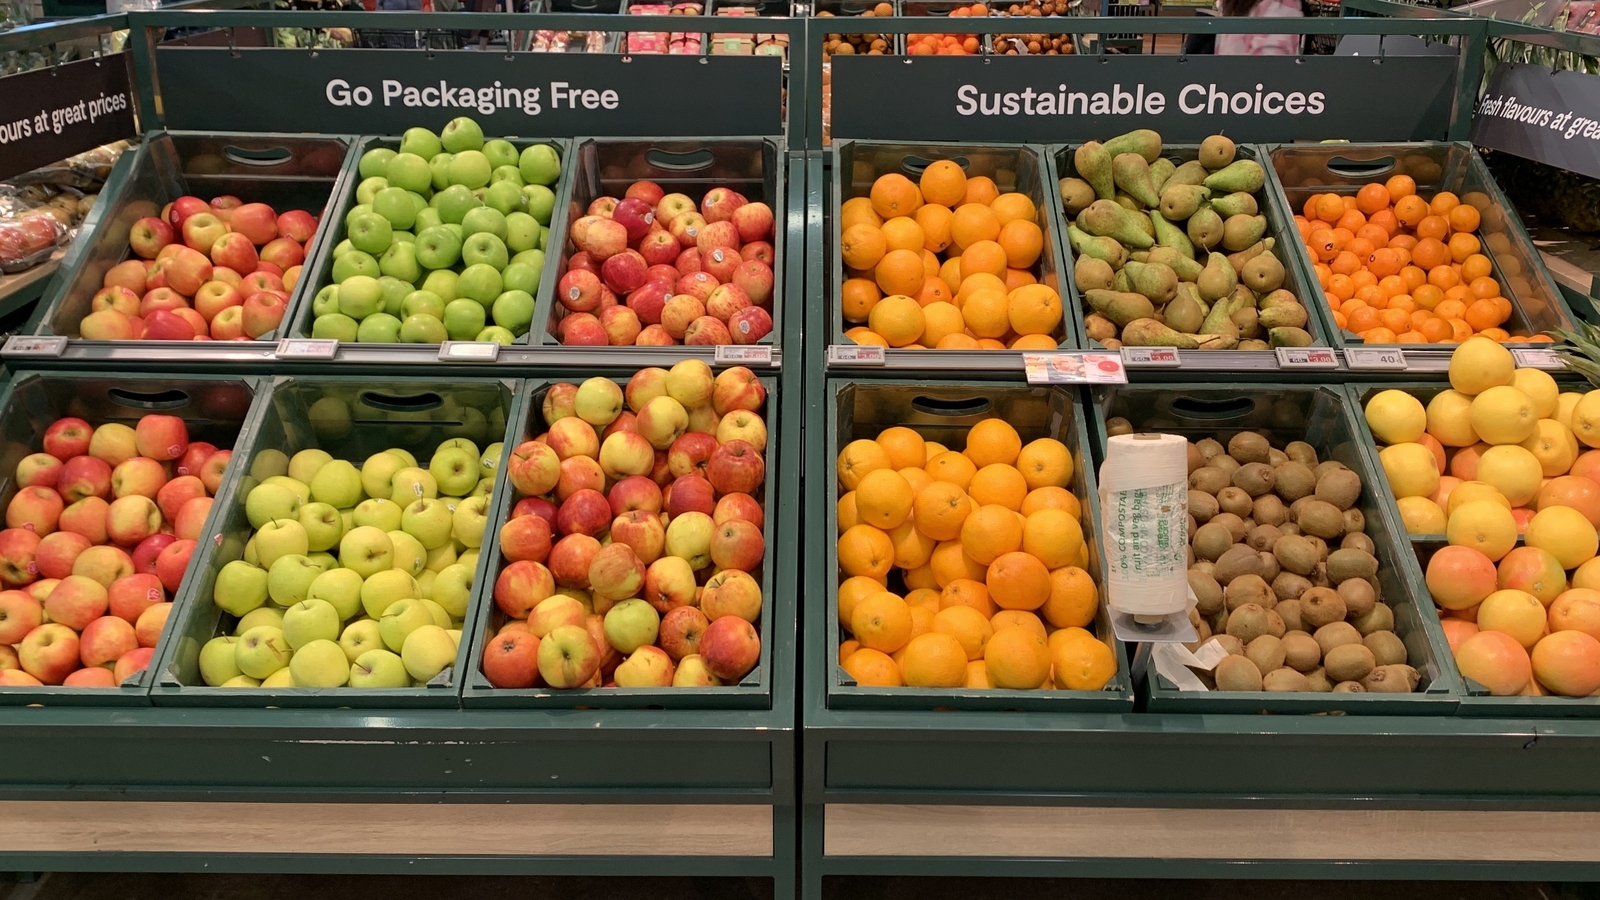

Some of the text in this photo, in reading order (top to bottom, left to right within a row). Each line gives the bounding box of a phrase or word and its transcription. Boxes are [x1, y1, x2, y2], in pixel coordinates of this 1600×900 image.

[326, 79, 619, 115] Go Packaging Free
[956, 84, 1325, 115] Sustainable Choices
[1478, 94, 1502, 116] Fresh
[1500, 96, 1553, 127] flavours
[1550, 111, 1573, 131] at
[0, 91, 127, 144] ours at great prices
[1132, 512, 1141, 530] veg
